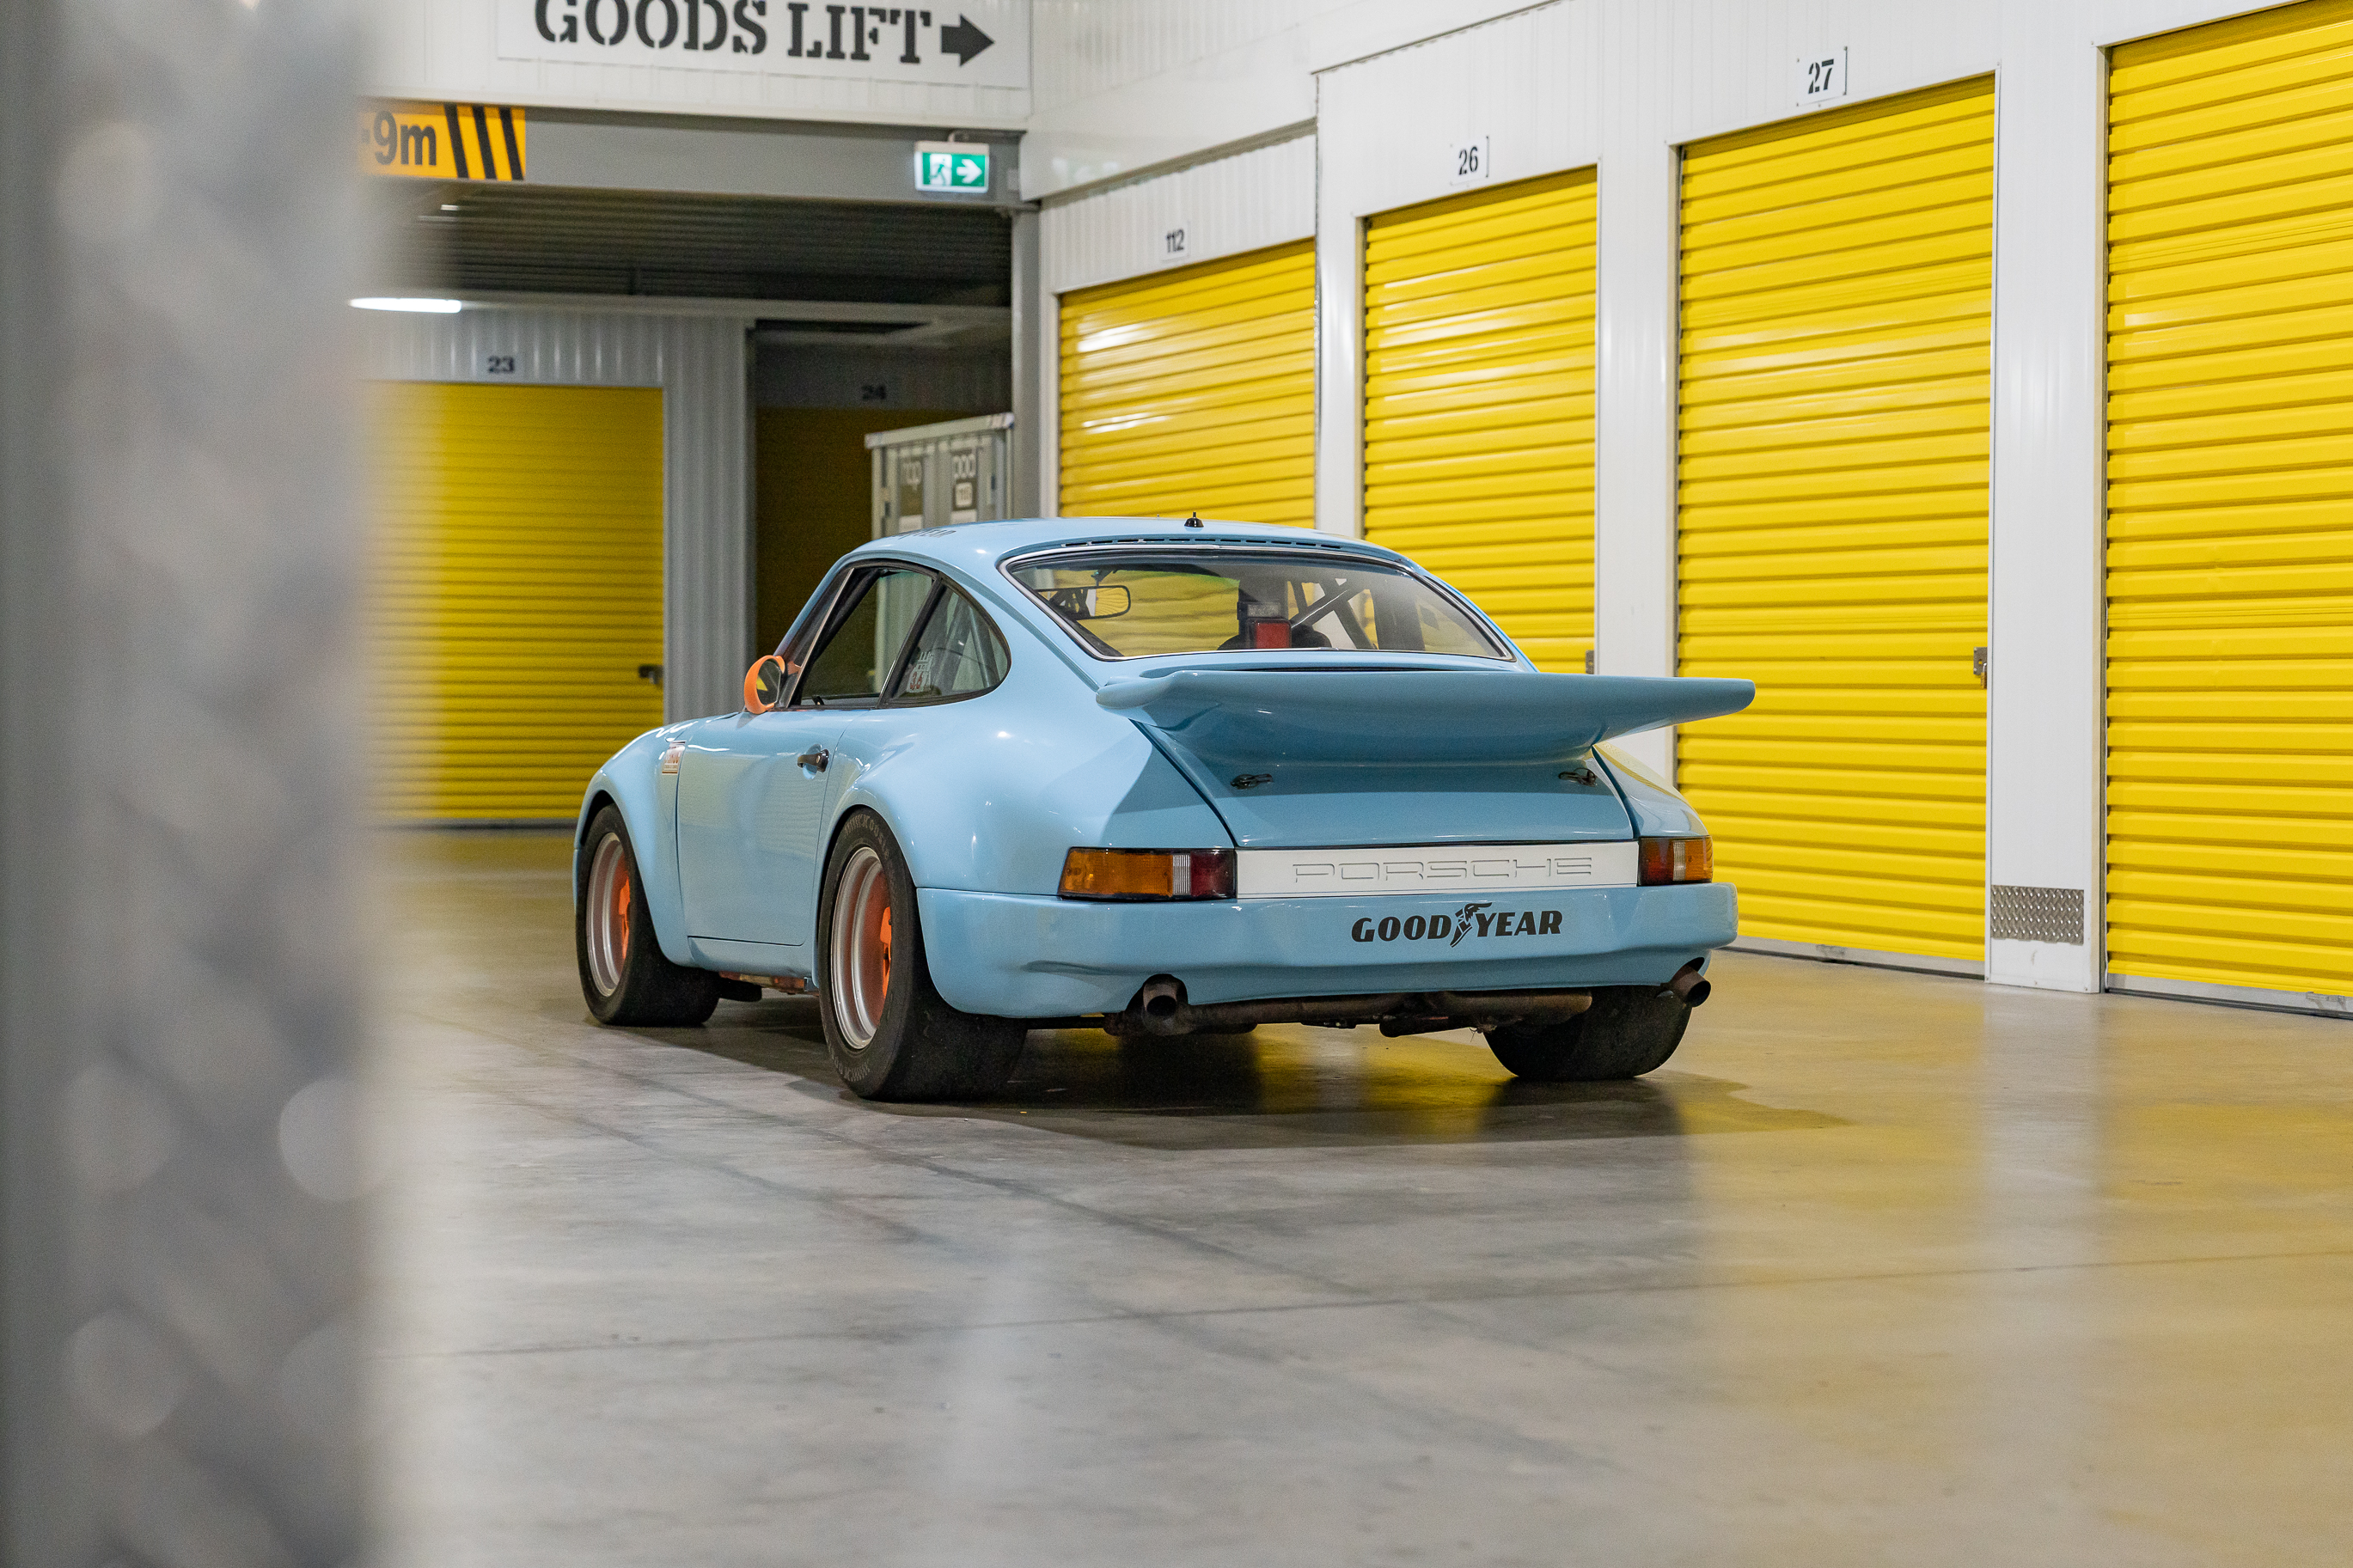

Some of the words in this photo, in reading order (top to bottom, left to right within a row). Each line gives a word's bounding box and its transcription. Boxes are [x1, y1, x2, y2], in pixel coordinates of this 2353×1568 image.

[535, 0, 767, 54] GOODS
[788, 3, 931, 64] LIFT
[1808, 58, 1834, 94] 27
[1458, 146, 1478, 175] 26
[1166, 229, 1184, 253] 112
[487, 355, 515, 374] 23
[1292, 857, 1592, 883] PORSCHE
